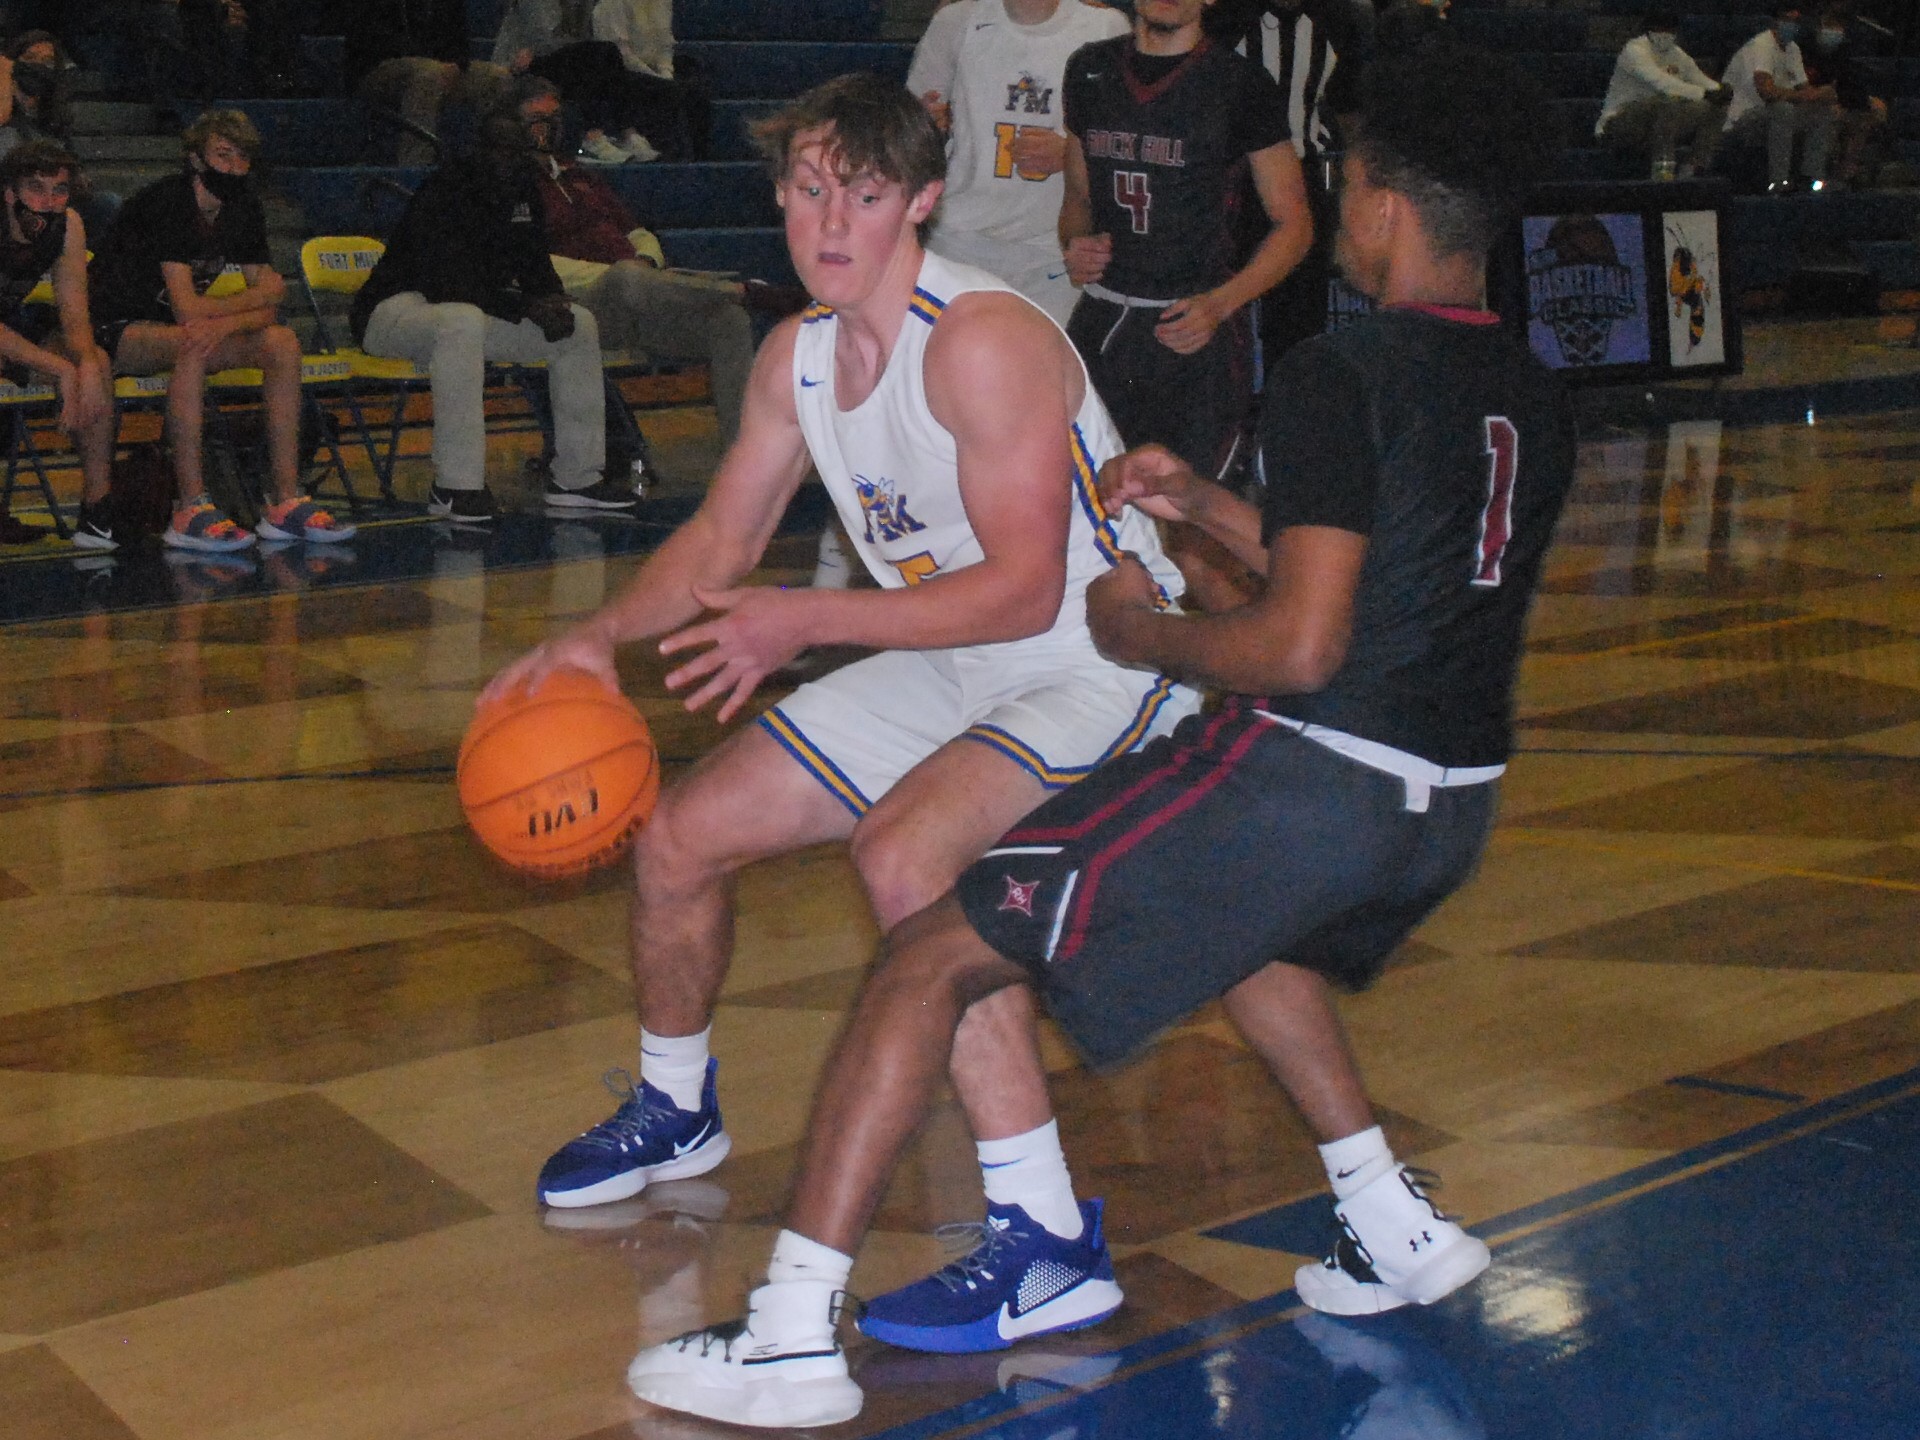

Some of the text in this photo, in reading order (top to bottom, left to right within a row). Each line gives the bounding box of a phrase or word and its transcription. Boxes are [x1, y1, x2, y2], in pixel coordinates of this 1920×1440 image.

[1141, 134, 1186, 167] HILL
[1113, 169, 1151, 234] 4
[317, 251, 349, 270] FORT
[1470, 415, 1519, 587] 1
